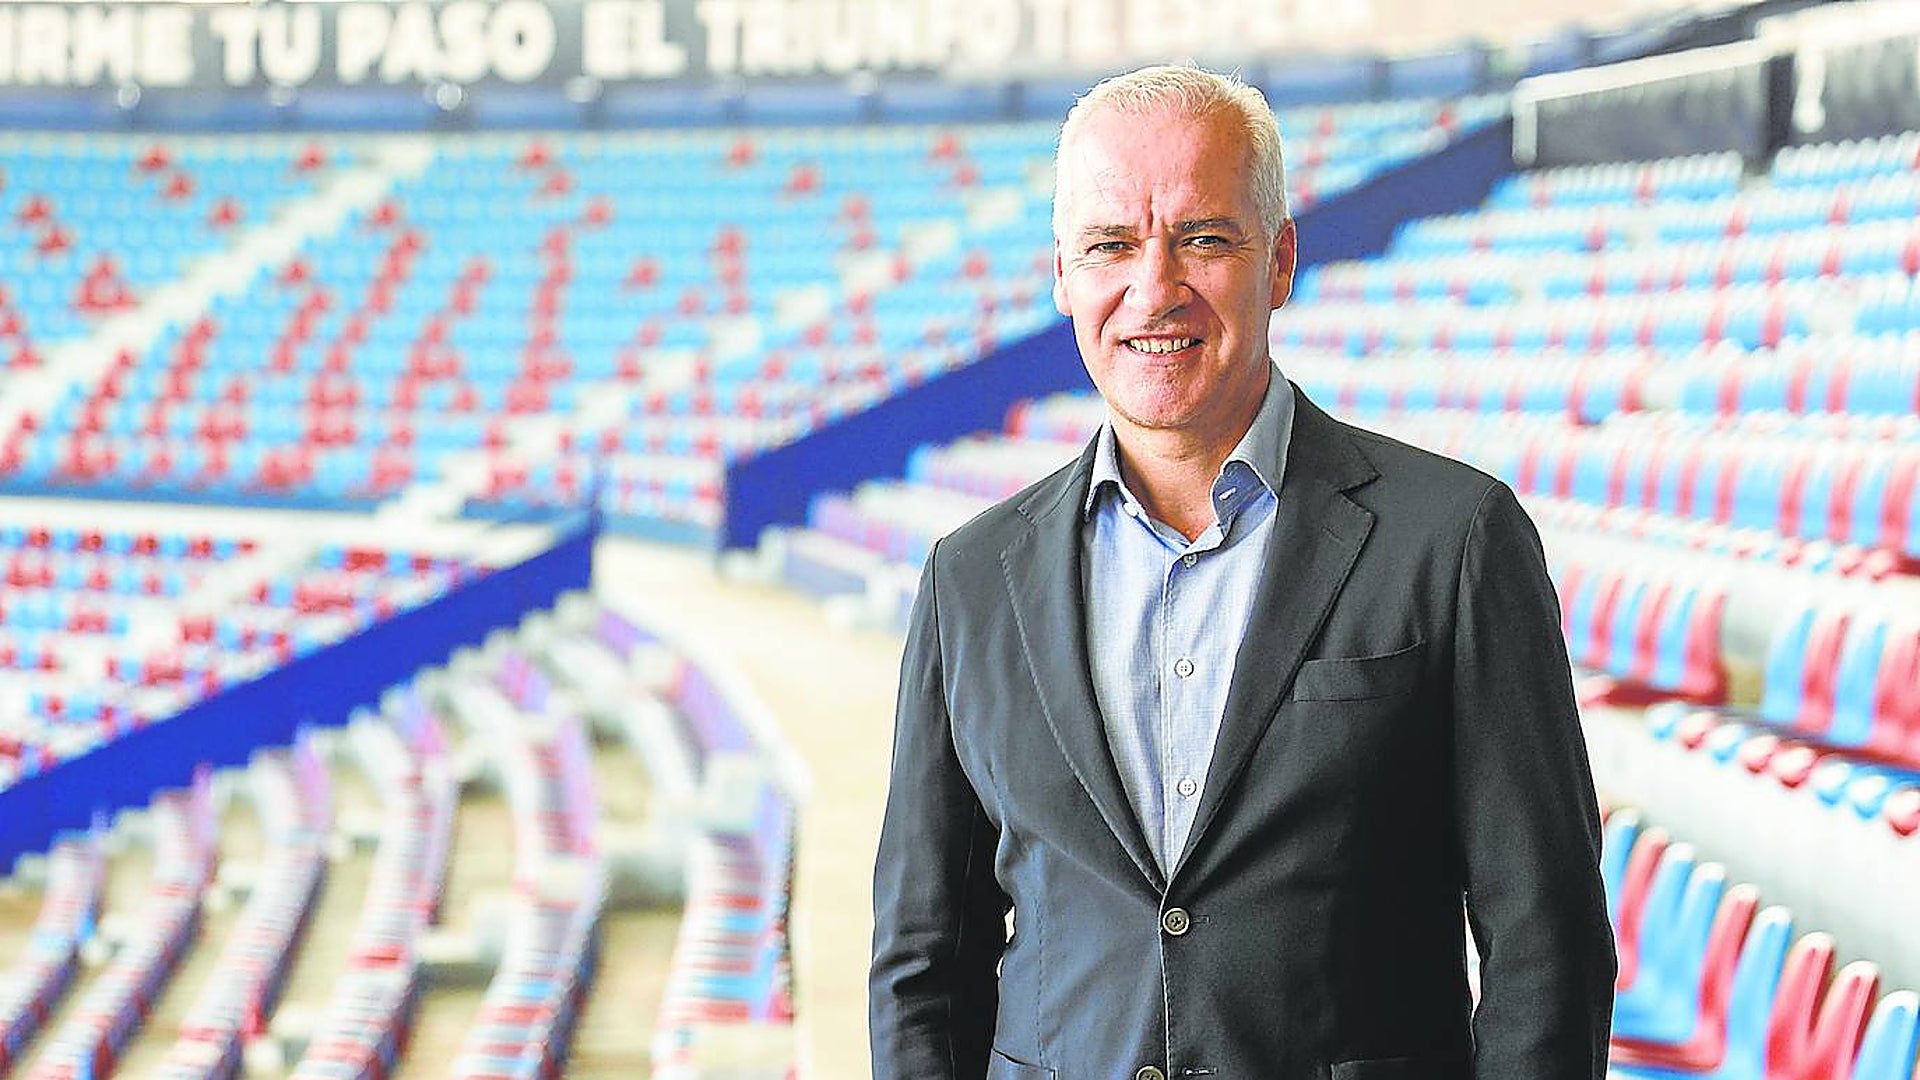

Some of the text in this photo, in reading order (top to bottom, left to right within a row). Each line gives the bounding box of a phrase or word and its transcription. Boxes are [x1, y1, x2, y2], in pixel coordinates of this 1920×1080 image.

[209, 4, 322, 86] TU
[335, 2, 557, 84] PASO
[582, 0, 688, 79] EL
